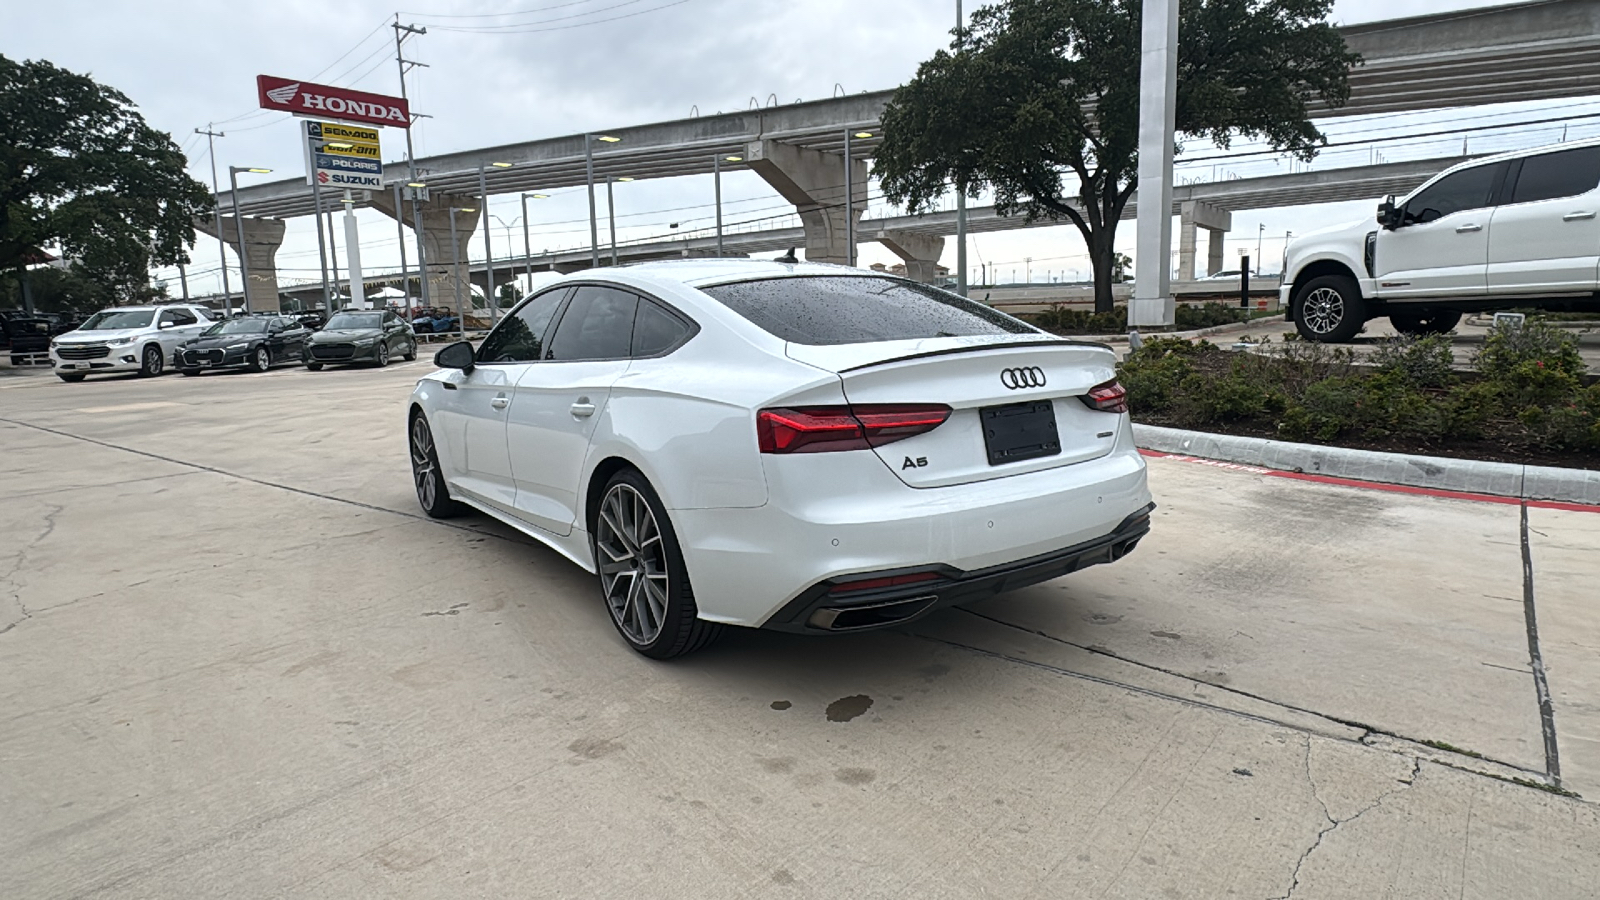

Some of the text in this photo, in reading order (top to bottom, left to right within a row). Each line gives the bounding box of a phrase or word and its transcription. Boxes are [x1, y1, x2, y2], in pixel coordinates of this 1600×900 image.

[301, 92, 407, 122] HONDA
[332, 159, 378, 170] POLARIS
[331, 174, 380, 186] SUZUKI
[902, 456, 928, 470] A5
